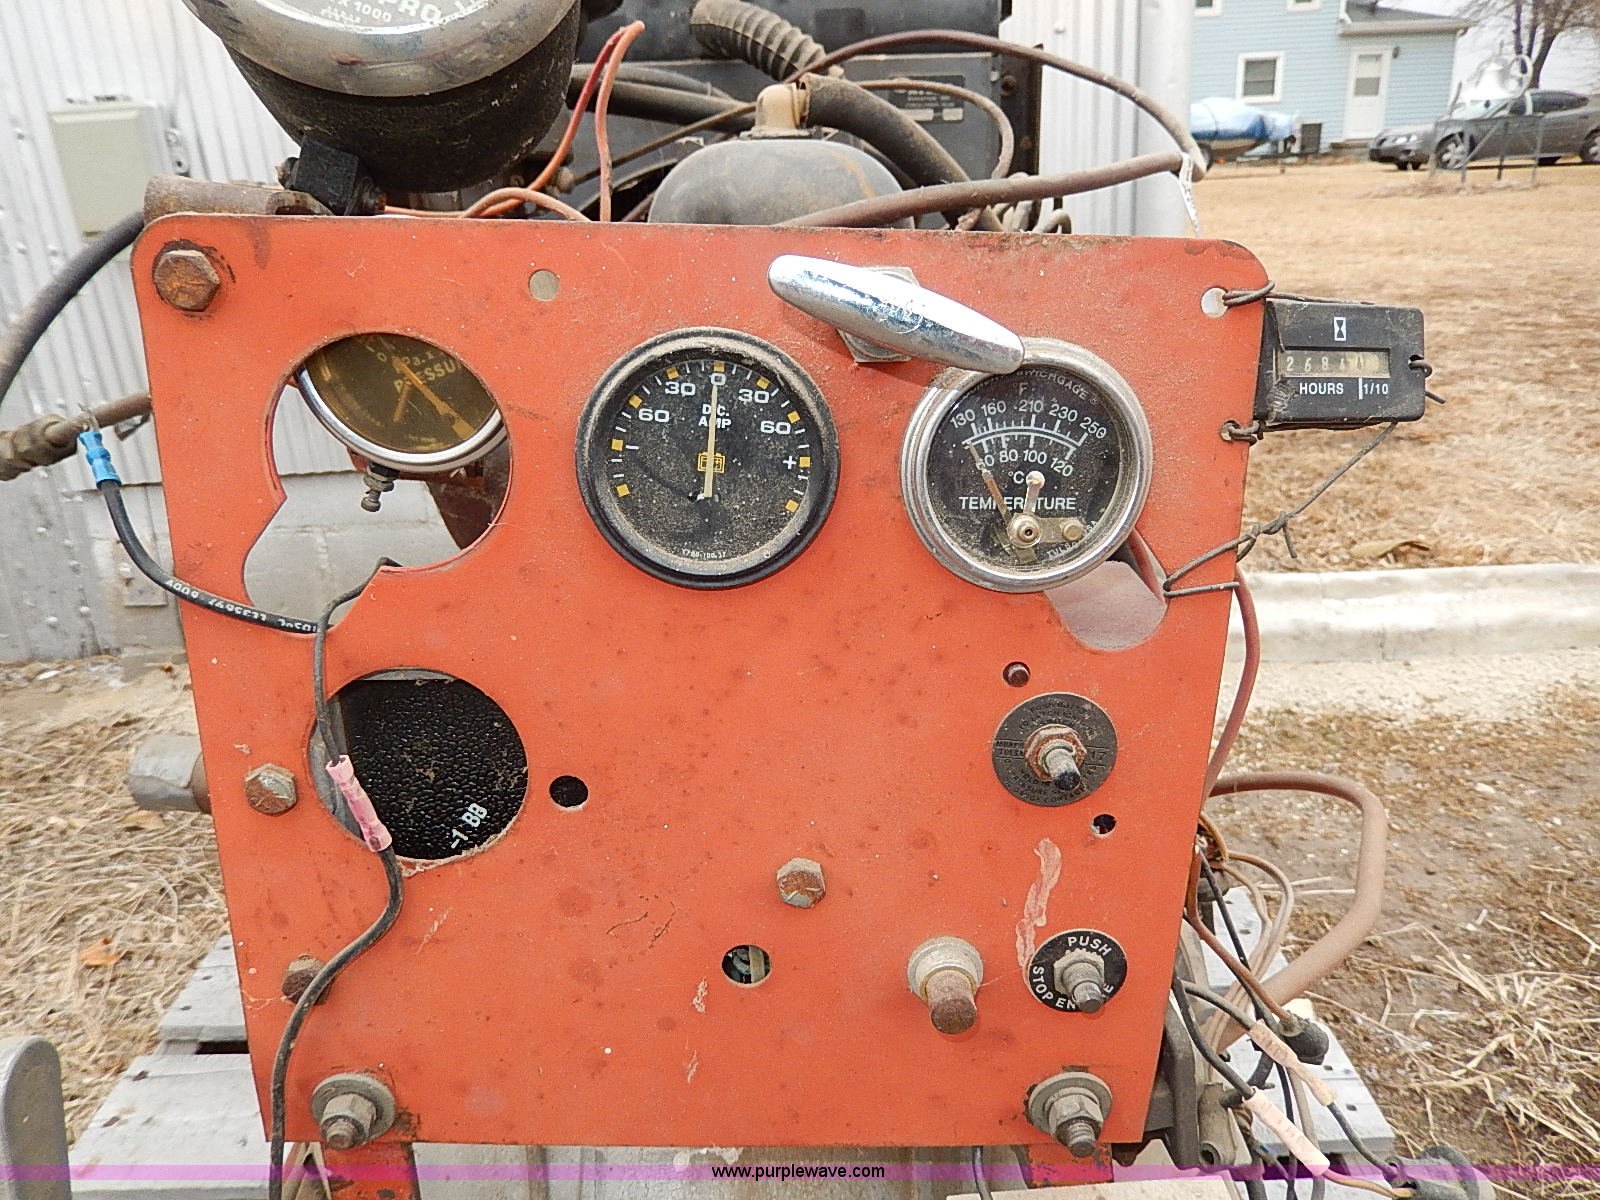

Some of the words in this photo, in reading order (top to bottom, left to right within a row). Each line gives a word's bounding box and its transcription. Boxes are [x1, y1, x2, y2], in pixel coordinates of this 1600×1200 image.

[710, 373, 726, 386] 0
[665, 381, 696, 396] 30
[738, 388, 770, 404] 30
[1299, 382, 1344, 396] HOURS
[1363, 383, 1389, 396] 1/10
[638, 408, 670, 423] 60
[949, 408, 976, 430] 130
[980, 400, 1007, 416] 160
[1018, 399, 1045, 414] 210
[1048, 402, 1078, 423] 230
[1079, 415, 1107, 439] 250
[760, 421, 791, 435] 60
[999, 448, 1019, 463] 80
[1023, 449, 1047, 465] 100
[1049, 457, 1074, 478] 120
[1067, 936, 1112, 956] PUSH
[1032, 966, 1054, 1000] STOP
